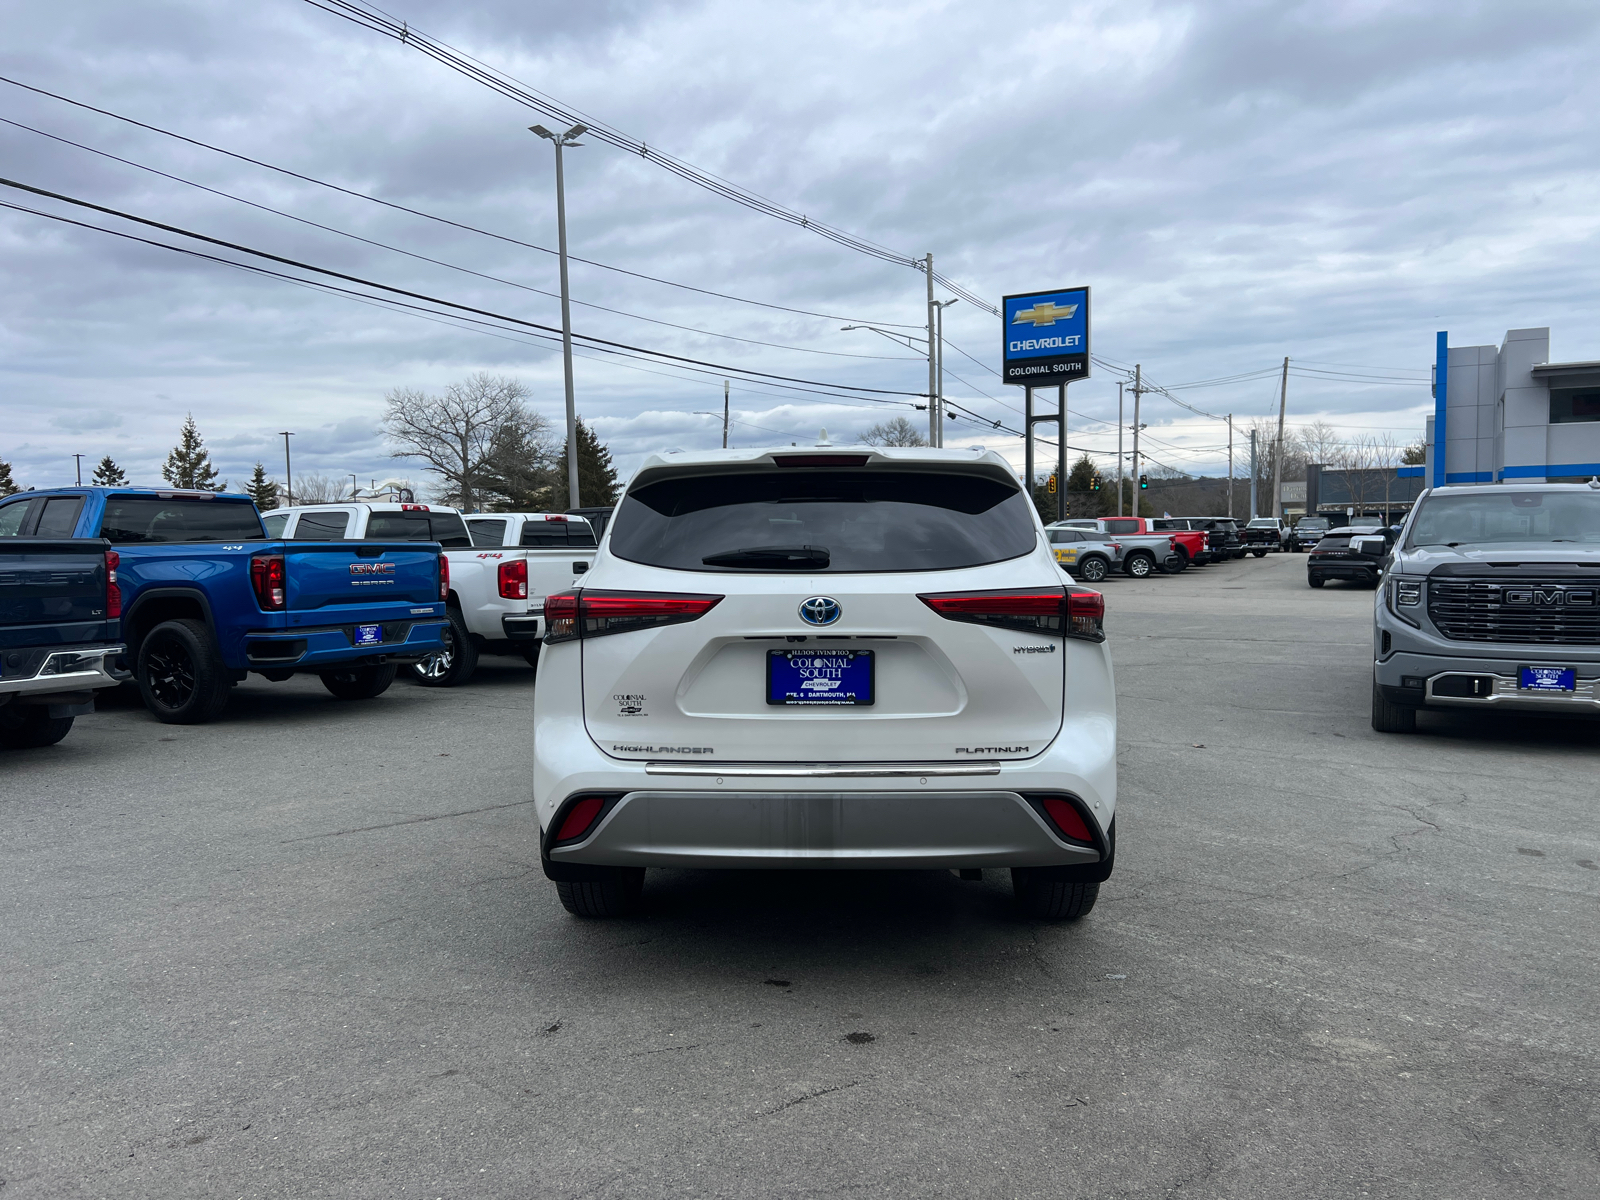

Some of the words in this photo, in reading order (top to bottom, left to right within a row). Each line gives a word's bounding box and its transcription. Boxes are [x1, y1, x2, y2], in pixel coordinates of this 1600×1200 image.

[1009, 335, 1081, 352] CHEVROLET
[1009, 365, 1051, 376] COLONIAL
[1052, 362, 1082, 373] SOUTH
[350, 563, 395, 575] GMC
[1506, 590, 1593, 605] GMC
[790, 658, 851, 668] COLONIAL
[800, 668, 841, 678] SOUTH
[613, 745, 714, 754] HIGHLANDER
[955, 746, 1029, 754] PLATINUM
